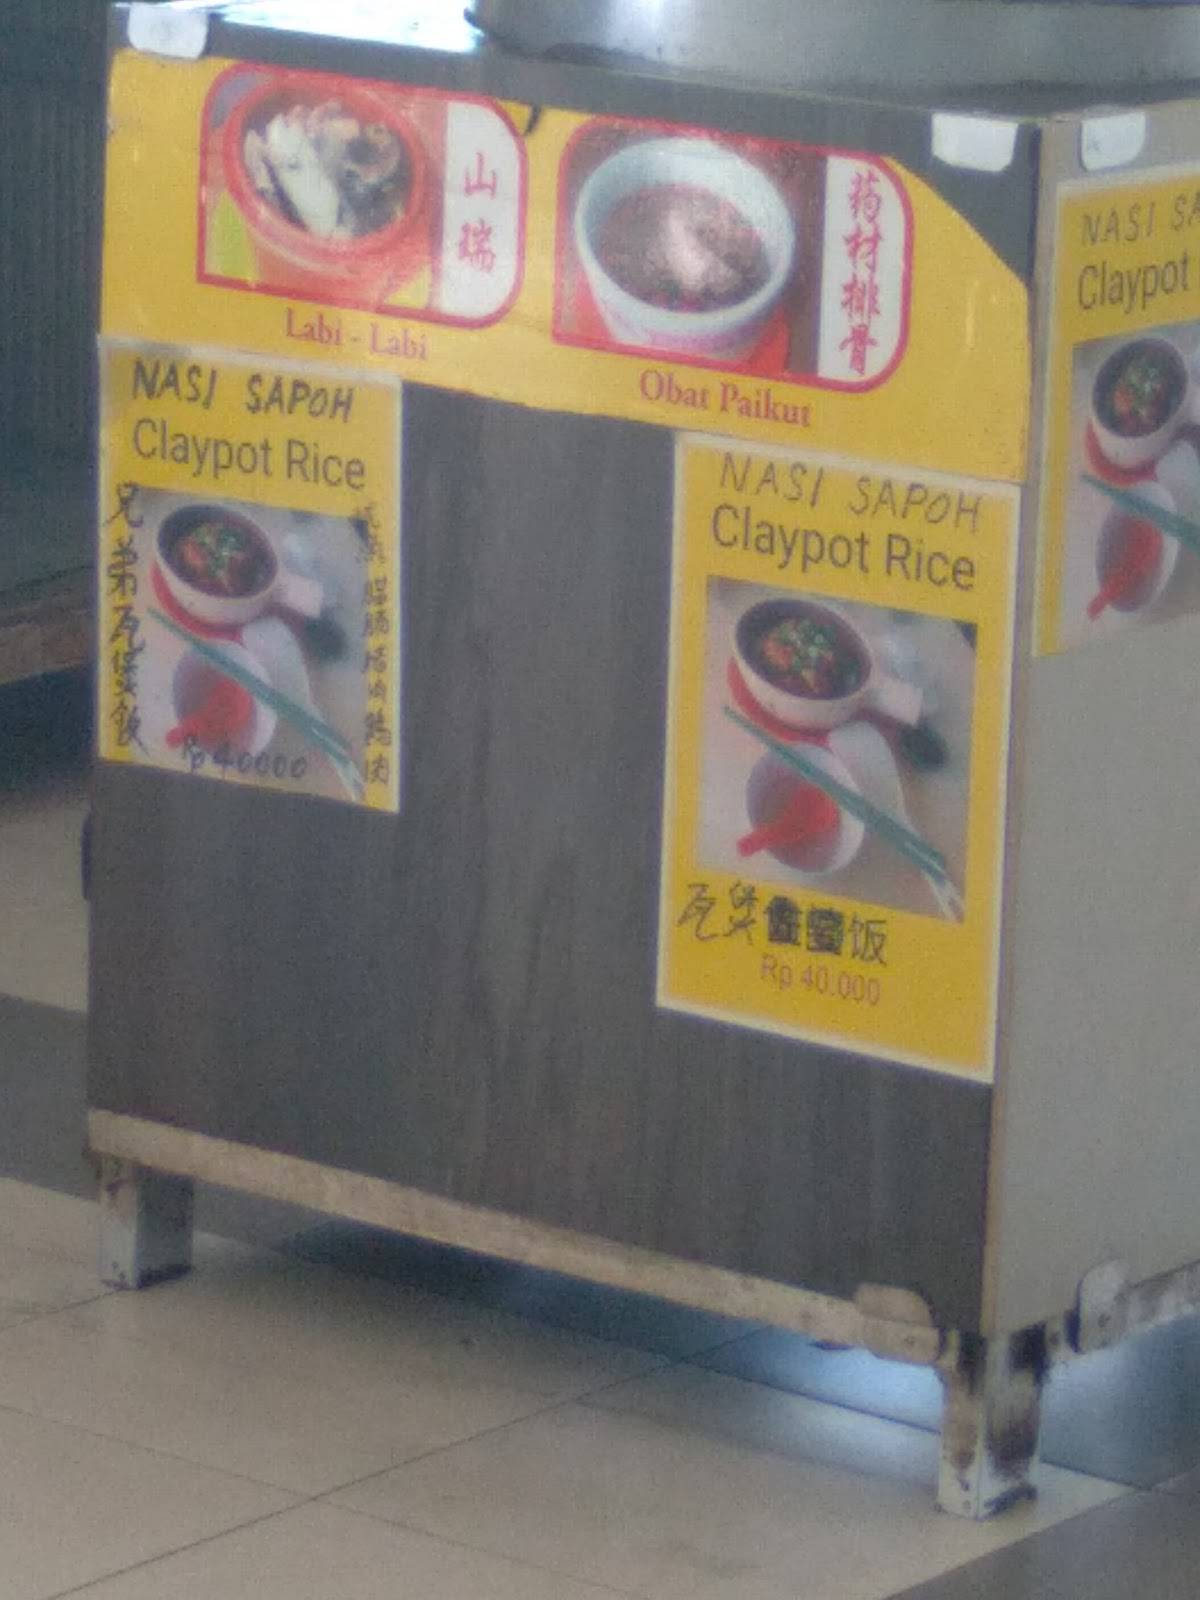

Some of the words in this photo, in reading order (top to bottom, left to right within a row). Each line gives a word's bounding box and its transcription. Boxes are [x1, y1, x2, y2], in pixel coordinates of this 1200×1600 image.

[1081, 201, 1156, 247] NASI
[1078, 249, 1191, 316] Claypot
[285, 306, 342, 346] Labi
[369, 322, 428, 361] Labi
[132, 357, 217, 410] NASI
[245, 373, 356, 423] SAPOH
[638, 369, 710, 412] Obat
[719, 382, 813, 428] Paikut
[133, 417, 274, 480] Claypot
[286, 438, 367, 490] Rice
[719, 452, 824, 509] NASI
[850, 475, 984, 536] SAPOH
[711, 502, 871, 573] Claypot
[884, 532, 977, 591] Rice
[760, 952, 793, 991] Rp
[800, 962, 881, 1006] 40.000
